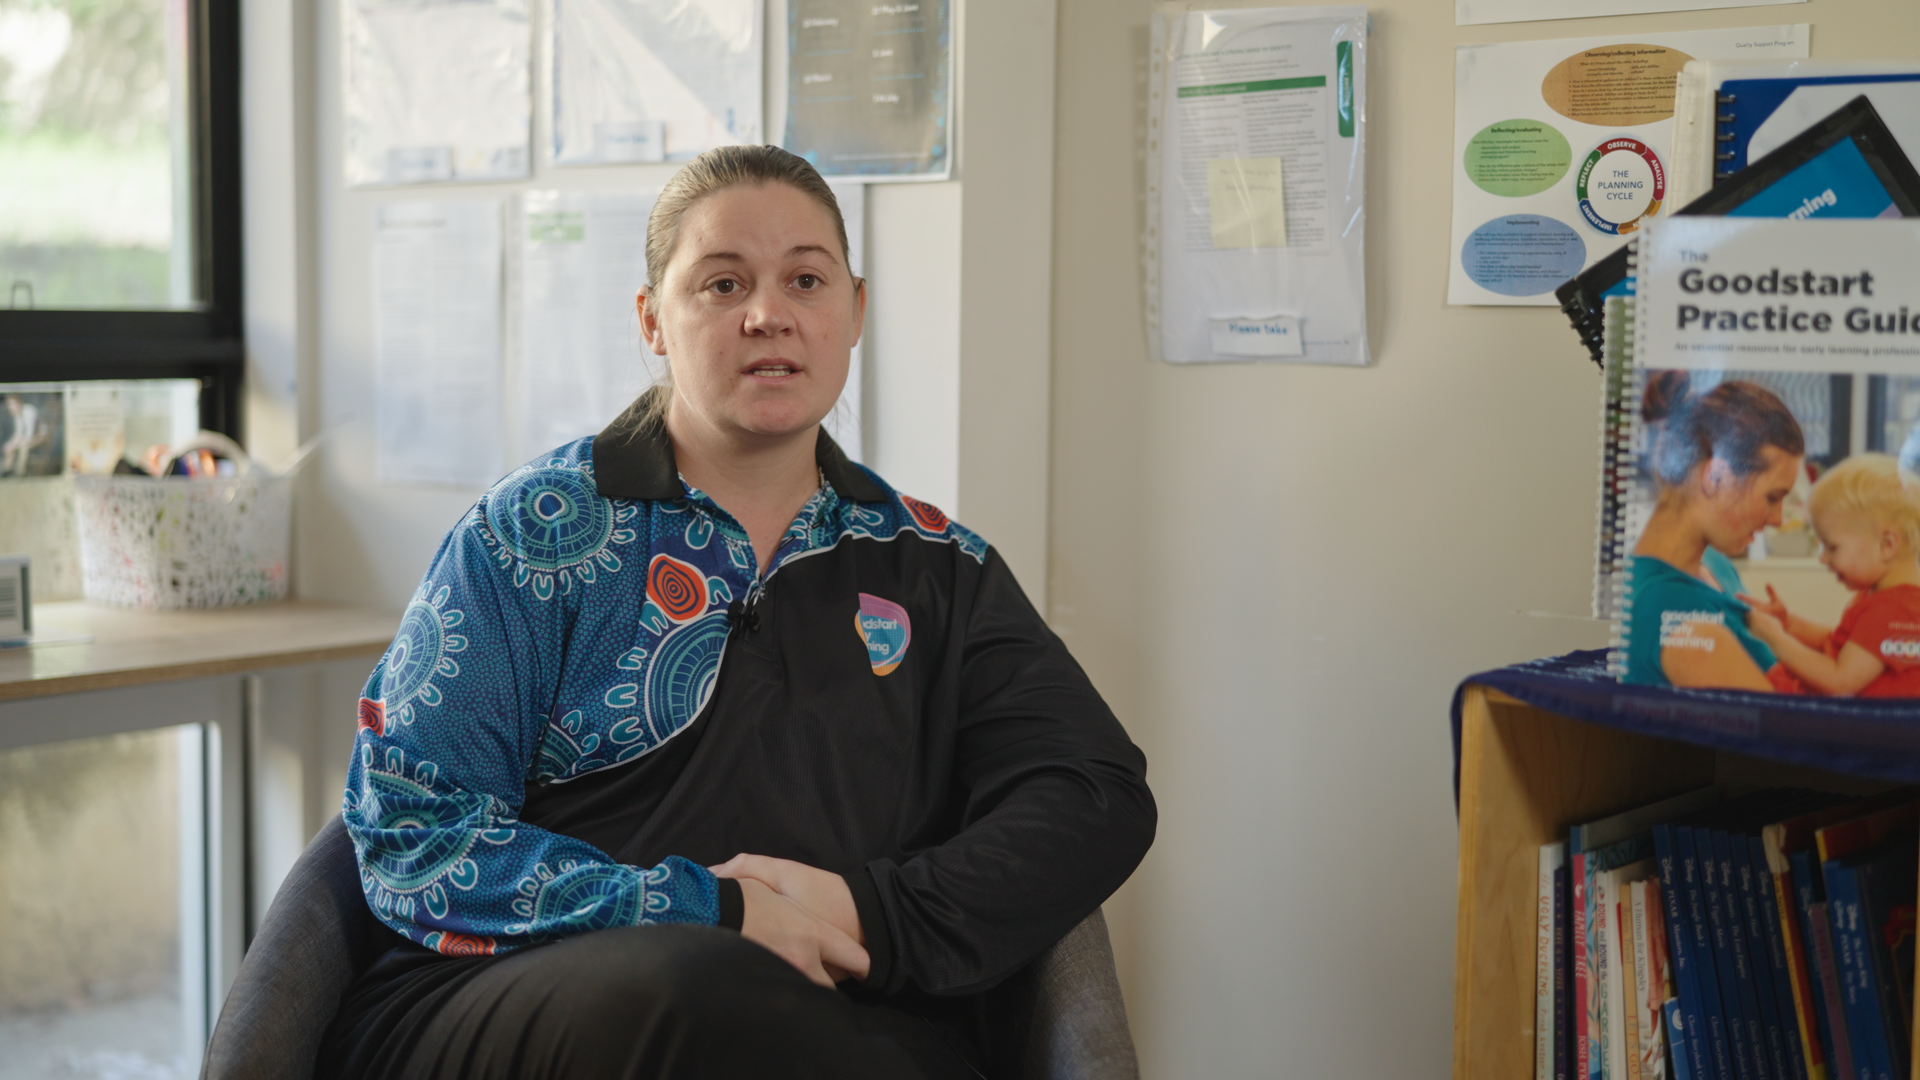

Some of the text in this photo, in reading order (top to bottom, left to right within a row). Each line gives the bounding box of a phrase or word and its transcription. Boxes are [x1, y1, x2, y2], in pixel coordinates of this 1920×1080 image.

[1607, 141, 1636, 150] OBSERVE
[1579, 159, 1594, 187] REFLECT
[1598, 181, 1643, 189] PLANNING
[1613, 170, 1629, 178] THE
[1651, 159, 1663, 189] ANALYSE
[1582, 204, 1612, 231] IMPLEMENT
[1679, 250, 1708, 263] The
[1679, 267, 1873, 296] Goodstart
[1229, 323, 1288, 335] Please take
[1677, 304, 1832, 333] Practice
[1737, 344, 1779, 353] resource
[1782, 344, 1797, 353] for
[1828, 345, 1869, 356] learning
[1660, 624, 1693, 637] early
[1661, 610, 1725, 625] goodstart
[1659, 634, 1715, 653] learning
[1704, 857, 1714, 885] Disney
[1721, 860, 1730, 887] Disney
[1740, 865, 1750, 892] Disney
[1759, 869, 1768, 896] Disney
[1661, 856, 1673, 885] Disney
[1668, 890, 1678, 918] PIXAR
[1673, 924, 1683, 956] Monsters,
[1684, 856, 1694, 883] Disney
[1690, 903, 1700, 922] Jungle
[1695, 924, 1704, 940] Book
[1540, 896, 1550, 932] UGLY
[1598, 903, 1606, 928] ROUND
[1635, 909, 1643, 940] Human
[1574, 910, 1586, 946] FAMILY
[1599, 944, 1607, 969] ROUND
[1624, 938, 1632, 964] Treml
[1539, 937, 1549, 996] DUCKLING
[1575, 955, 1586, 978] TREE
[1637, 956, 1646, 992] Kingsley
[1600, 983, 1610, 1080] GARDEN
[1578, 1035, 1586, 1058] JOSH
